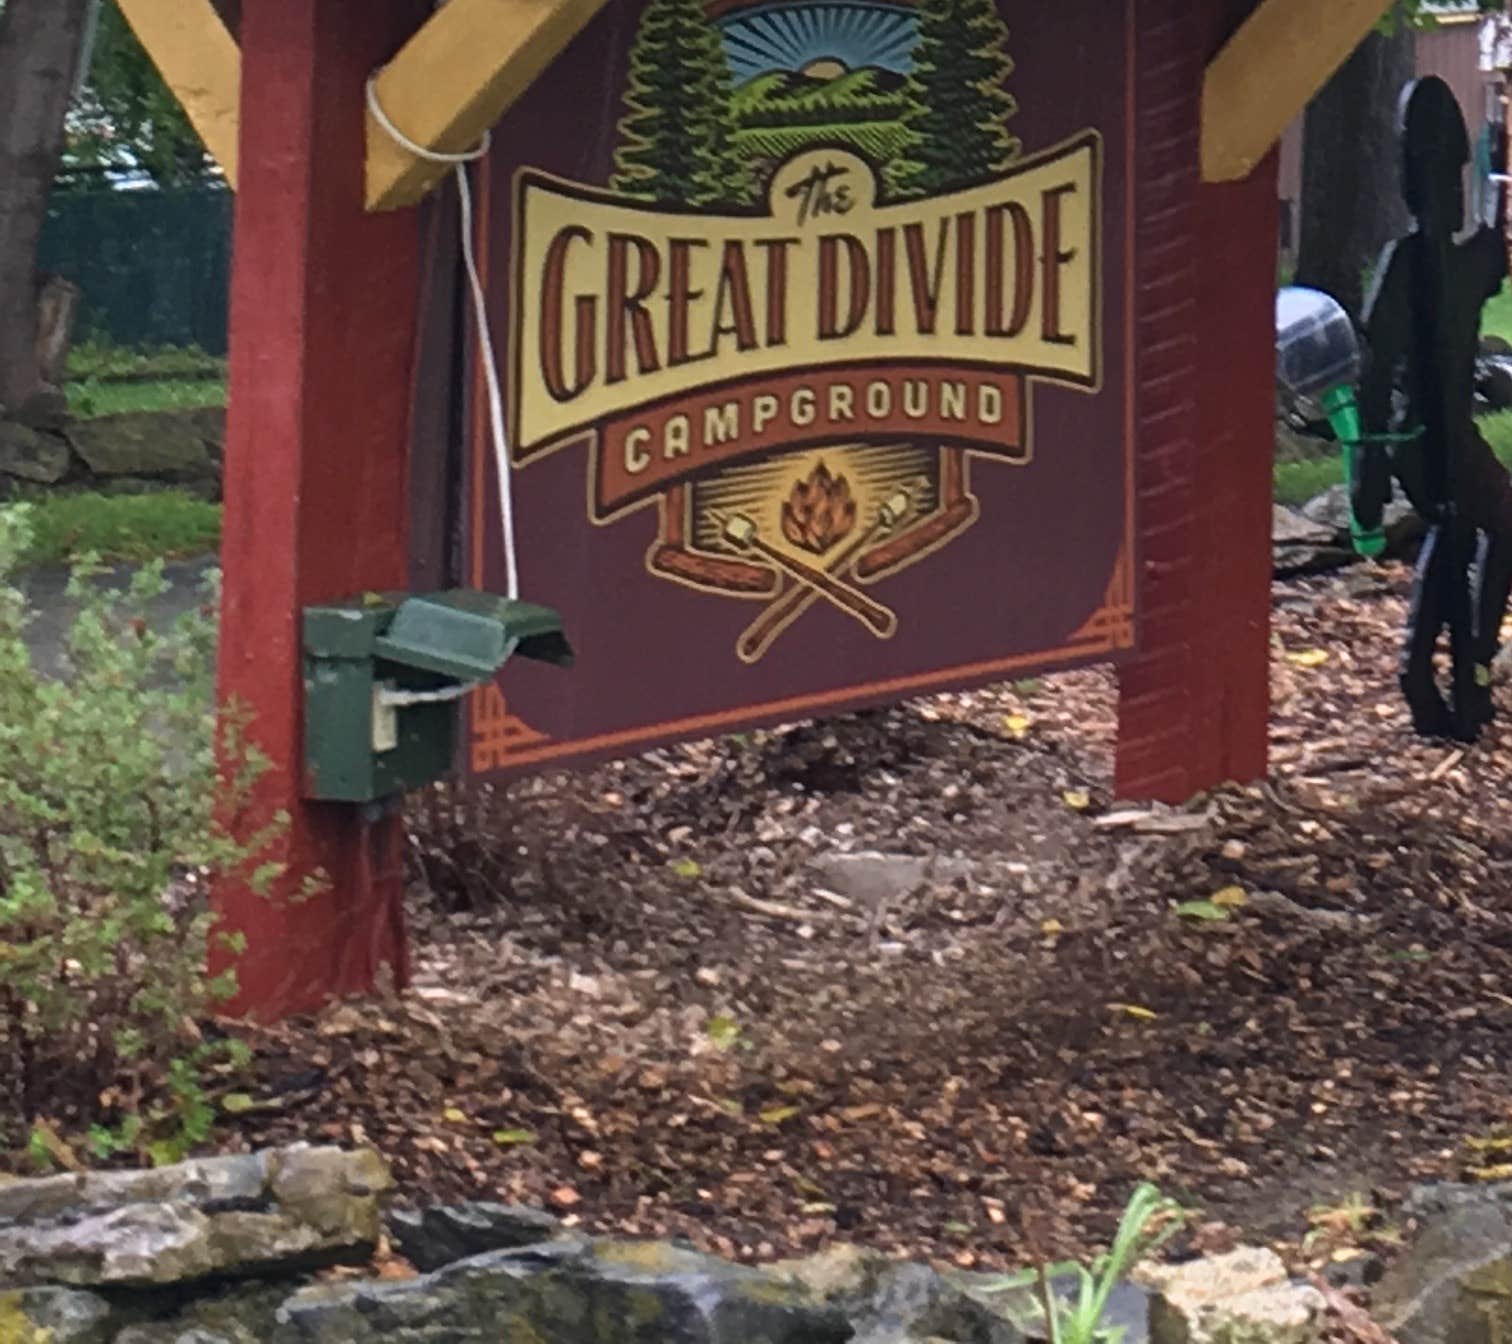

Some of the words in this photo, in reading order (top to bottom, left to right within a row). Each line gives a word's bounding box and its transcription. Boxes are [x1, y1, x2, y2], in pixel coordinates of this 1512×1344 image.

[784, 160, 855, 226] The
[539, 224, 801, 404] GREAT
[816, 182, 1078, 347] DIVIDE
[623, 380, 1003, 475] CAMPGROUND
